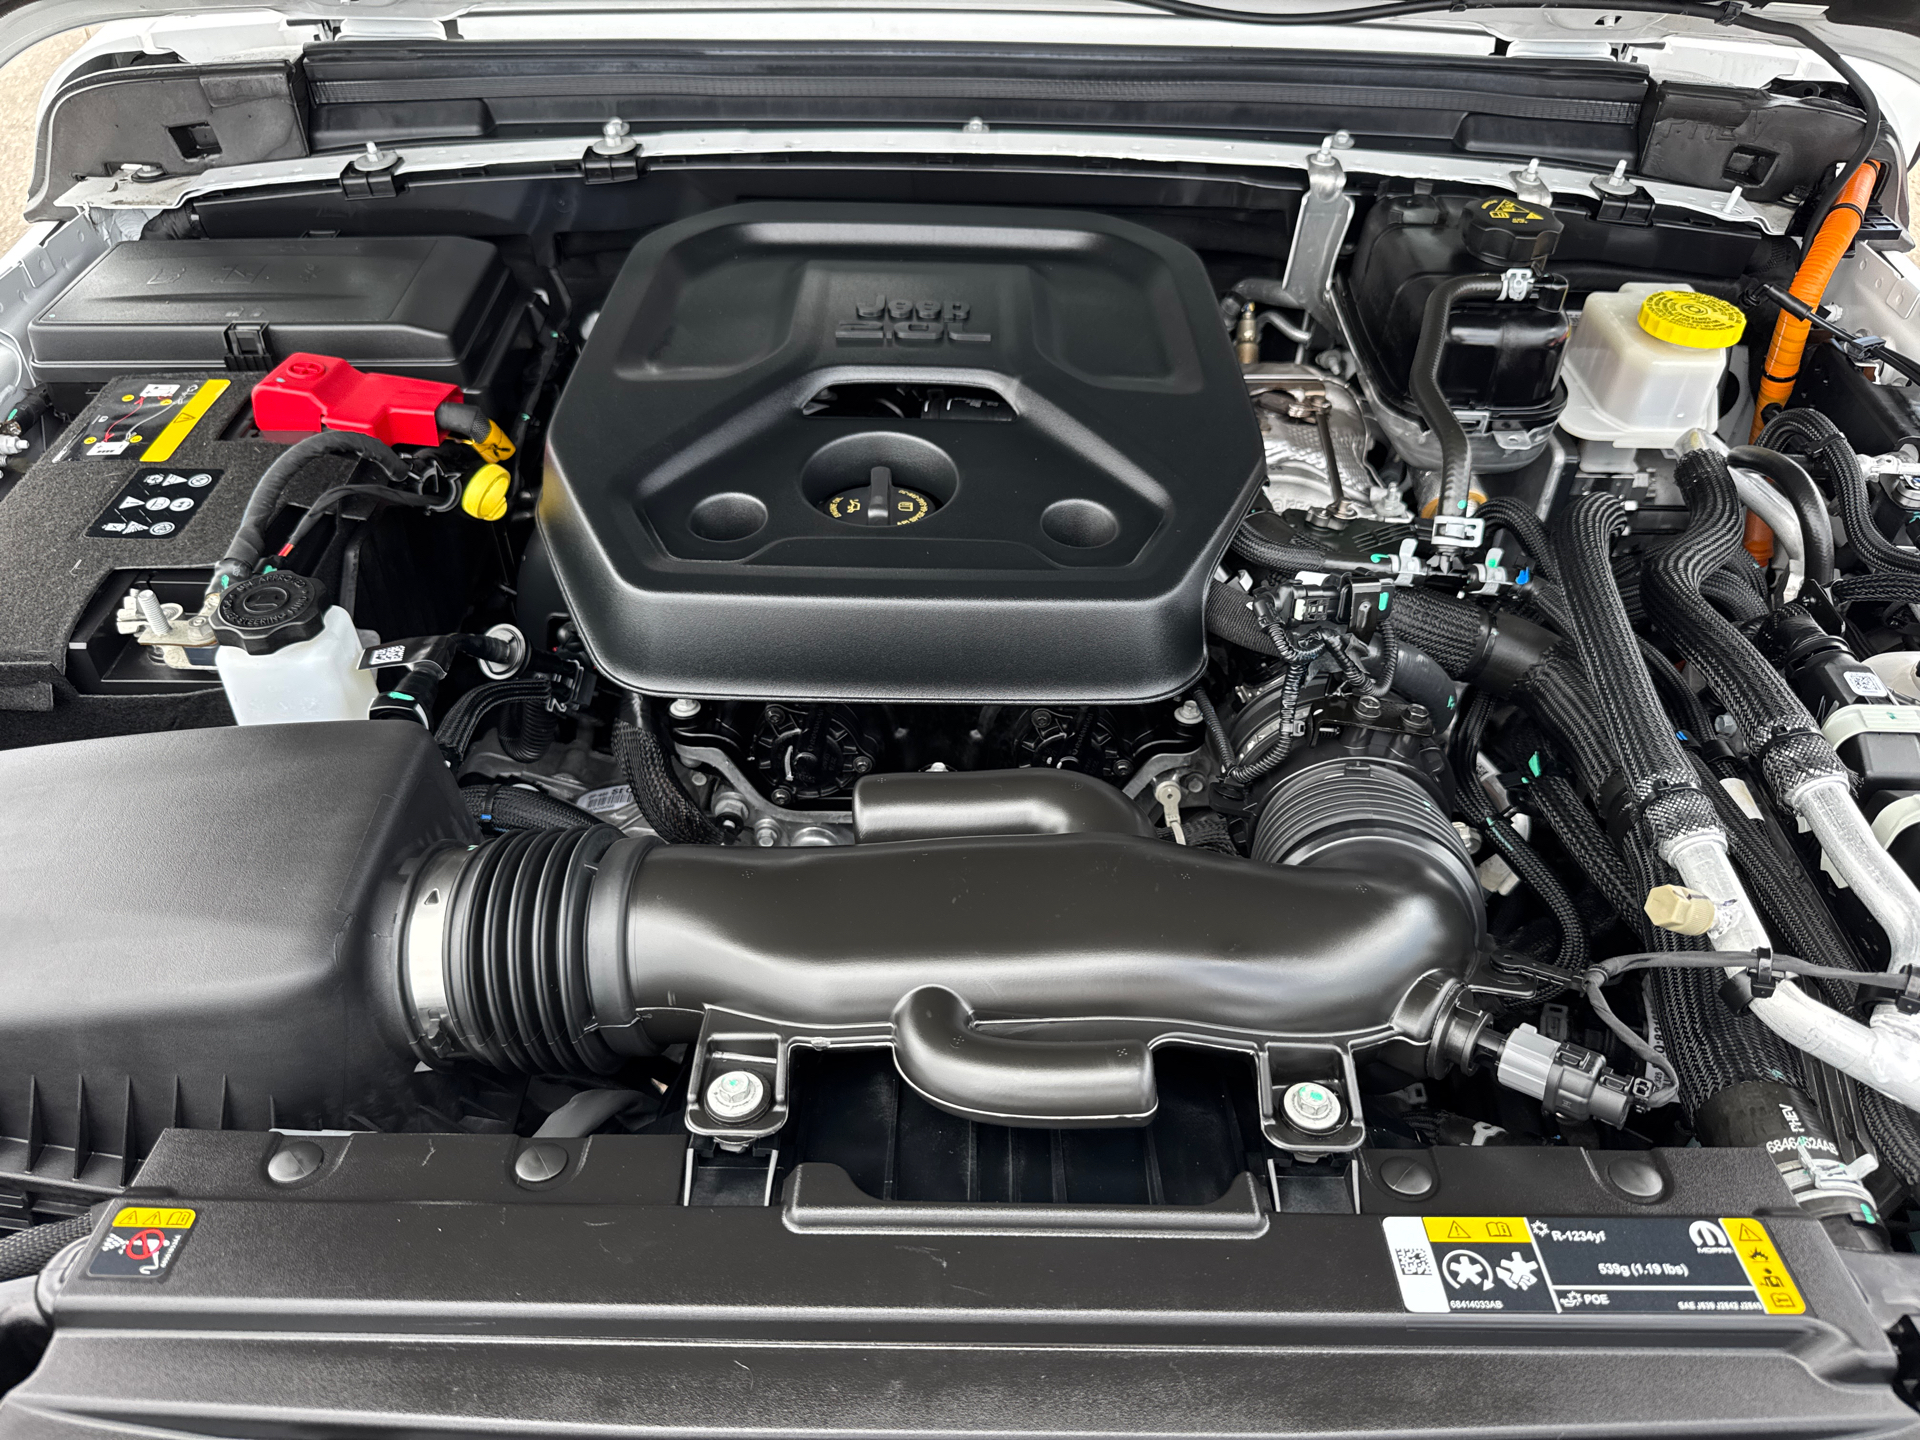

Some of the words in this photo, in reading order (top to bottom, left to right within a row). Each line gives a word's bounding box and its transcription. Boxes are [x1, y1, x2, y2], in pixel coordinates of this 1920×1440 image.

[856, 294, 971, 323] Jeep
[258, 573, 307, 588] APPROVED
[237, 613, 287, 627] STEERING
[1778, 1103, 1805, 1133] PHEV
[1551, 1230, 1606, 1244] R-1234yf
[1597, 1262, 1630, 1277] 539g
[1631, 1262, 1661, 1277] (1.19
[1662, 1262, 1689, 1277] lbs)
[1449, 1299, 1504, 1309] 68414033AB
[1583, 1294, 1610, 1305] POE
[1677, 1301, 1696, 1310] SAE
